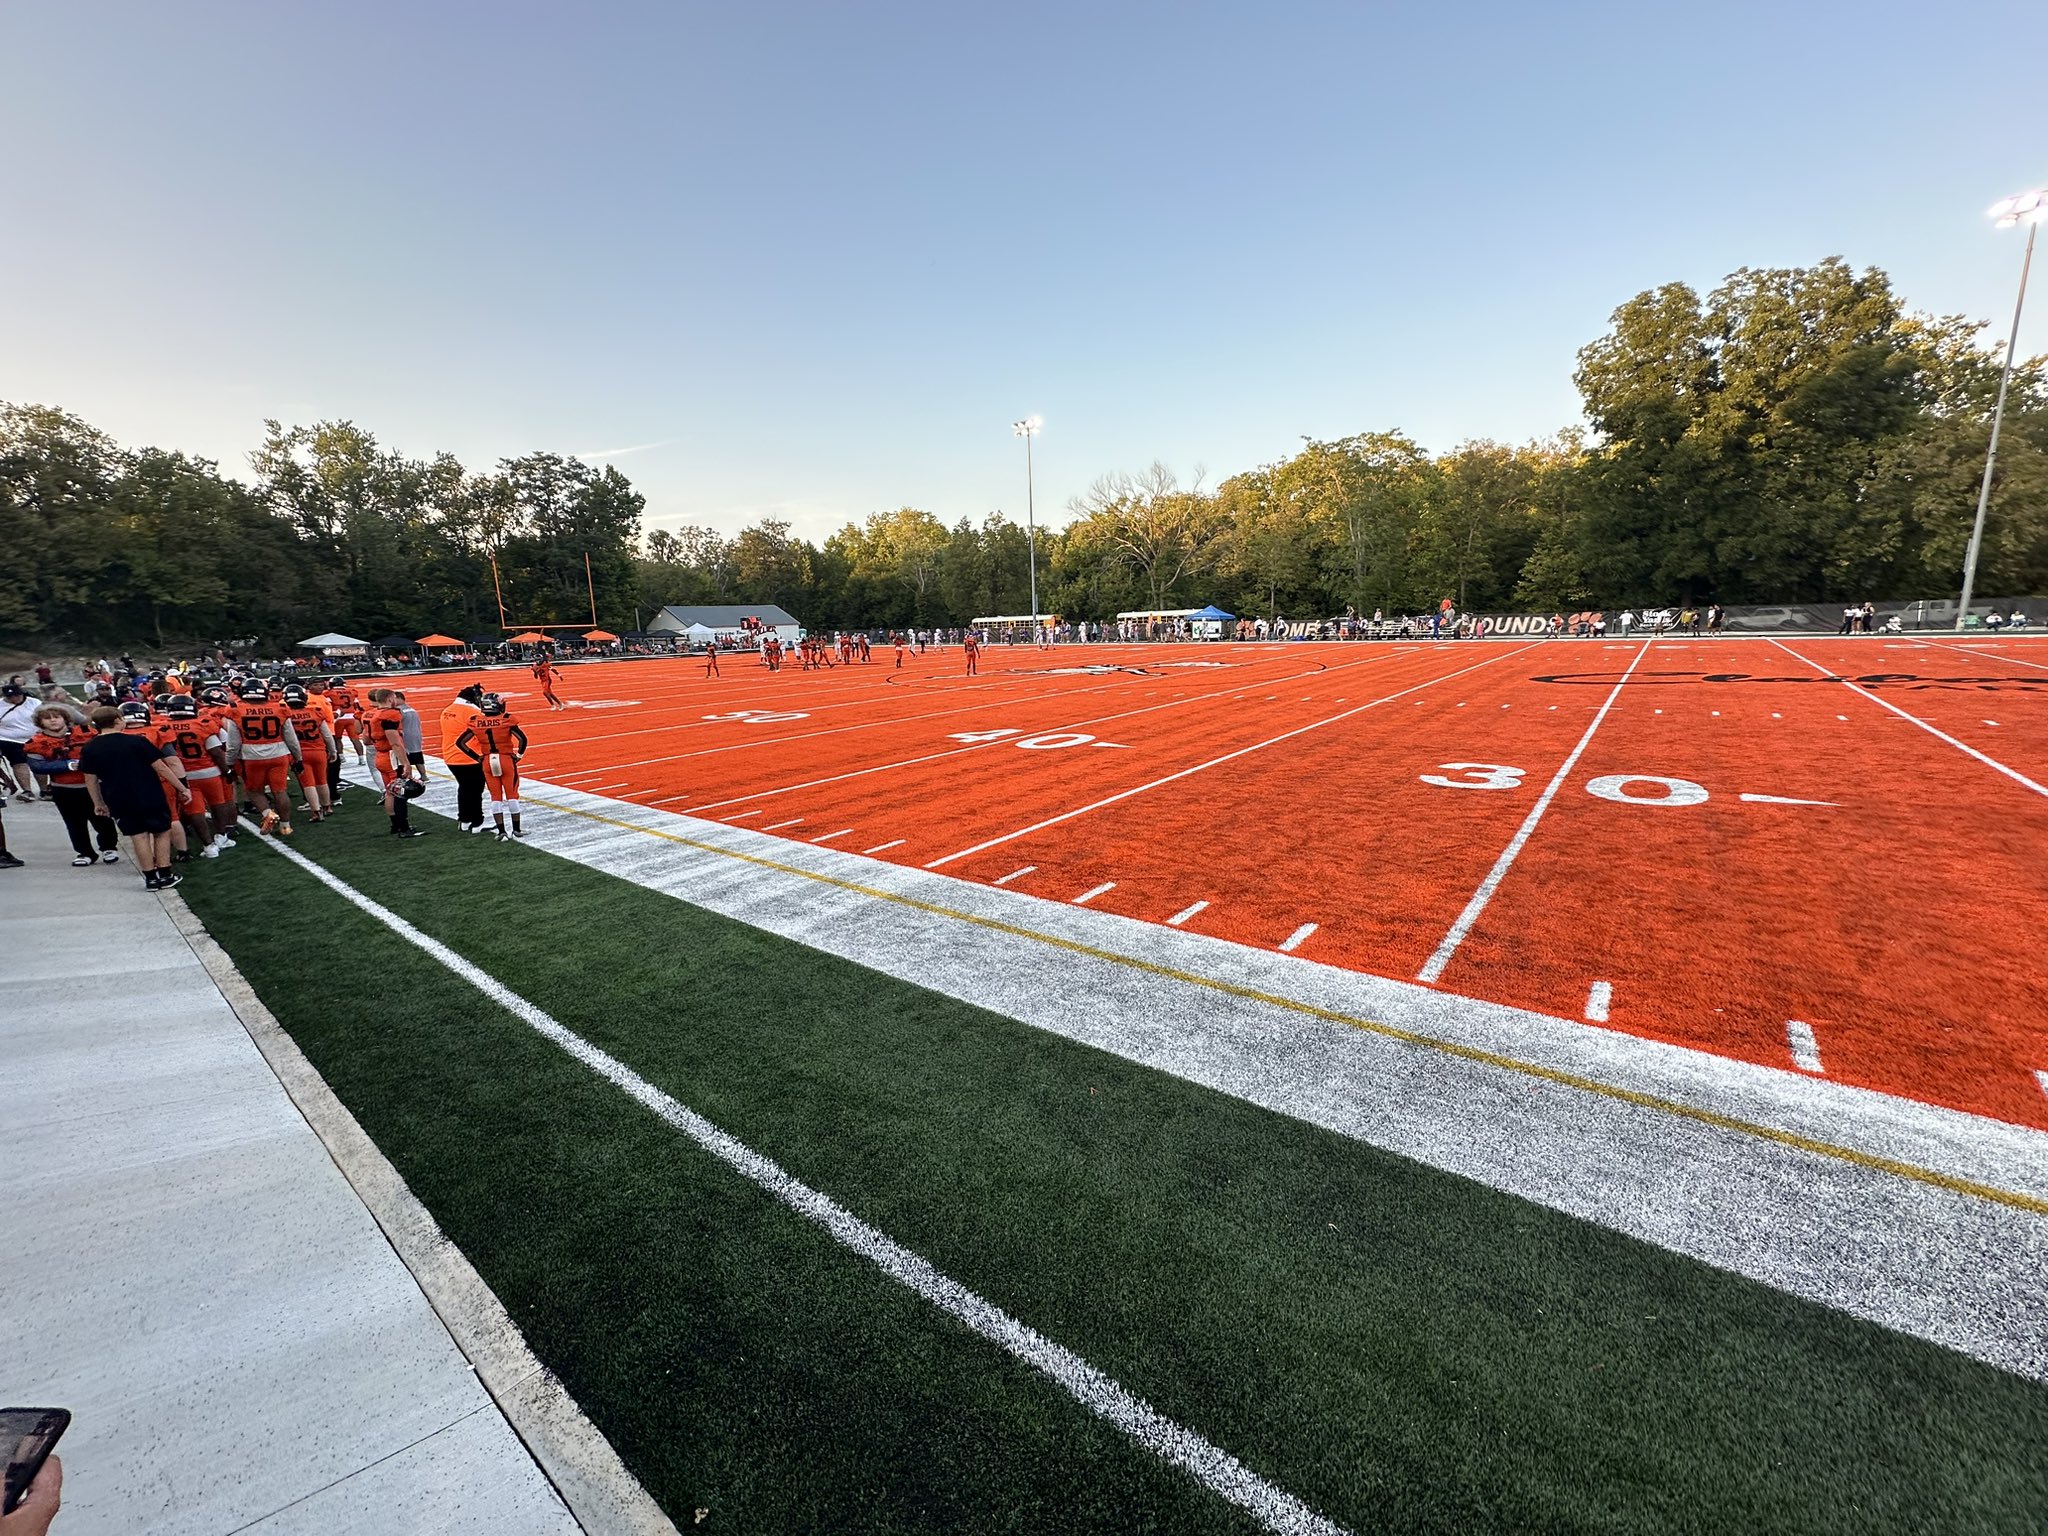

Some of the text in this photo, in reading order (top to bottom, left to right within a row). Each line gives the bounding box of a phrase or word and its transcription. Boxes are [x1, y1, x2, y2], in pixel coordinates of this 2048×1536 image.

[246, 708, 274, 716] PARIS
[291, 712, 312, 720] ARIS
[166, 723, 190, 731] ARIS
[241, 715, 282, 741] 50
[477, 719, 501, 728] PARIS
[485, 728, 500, 753] 1
[945, 728, 1098, 750] 40
[1419, 762, 1711, 806] 30
